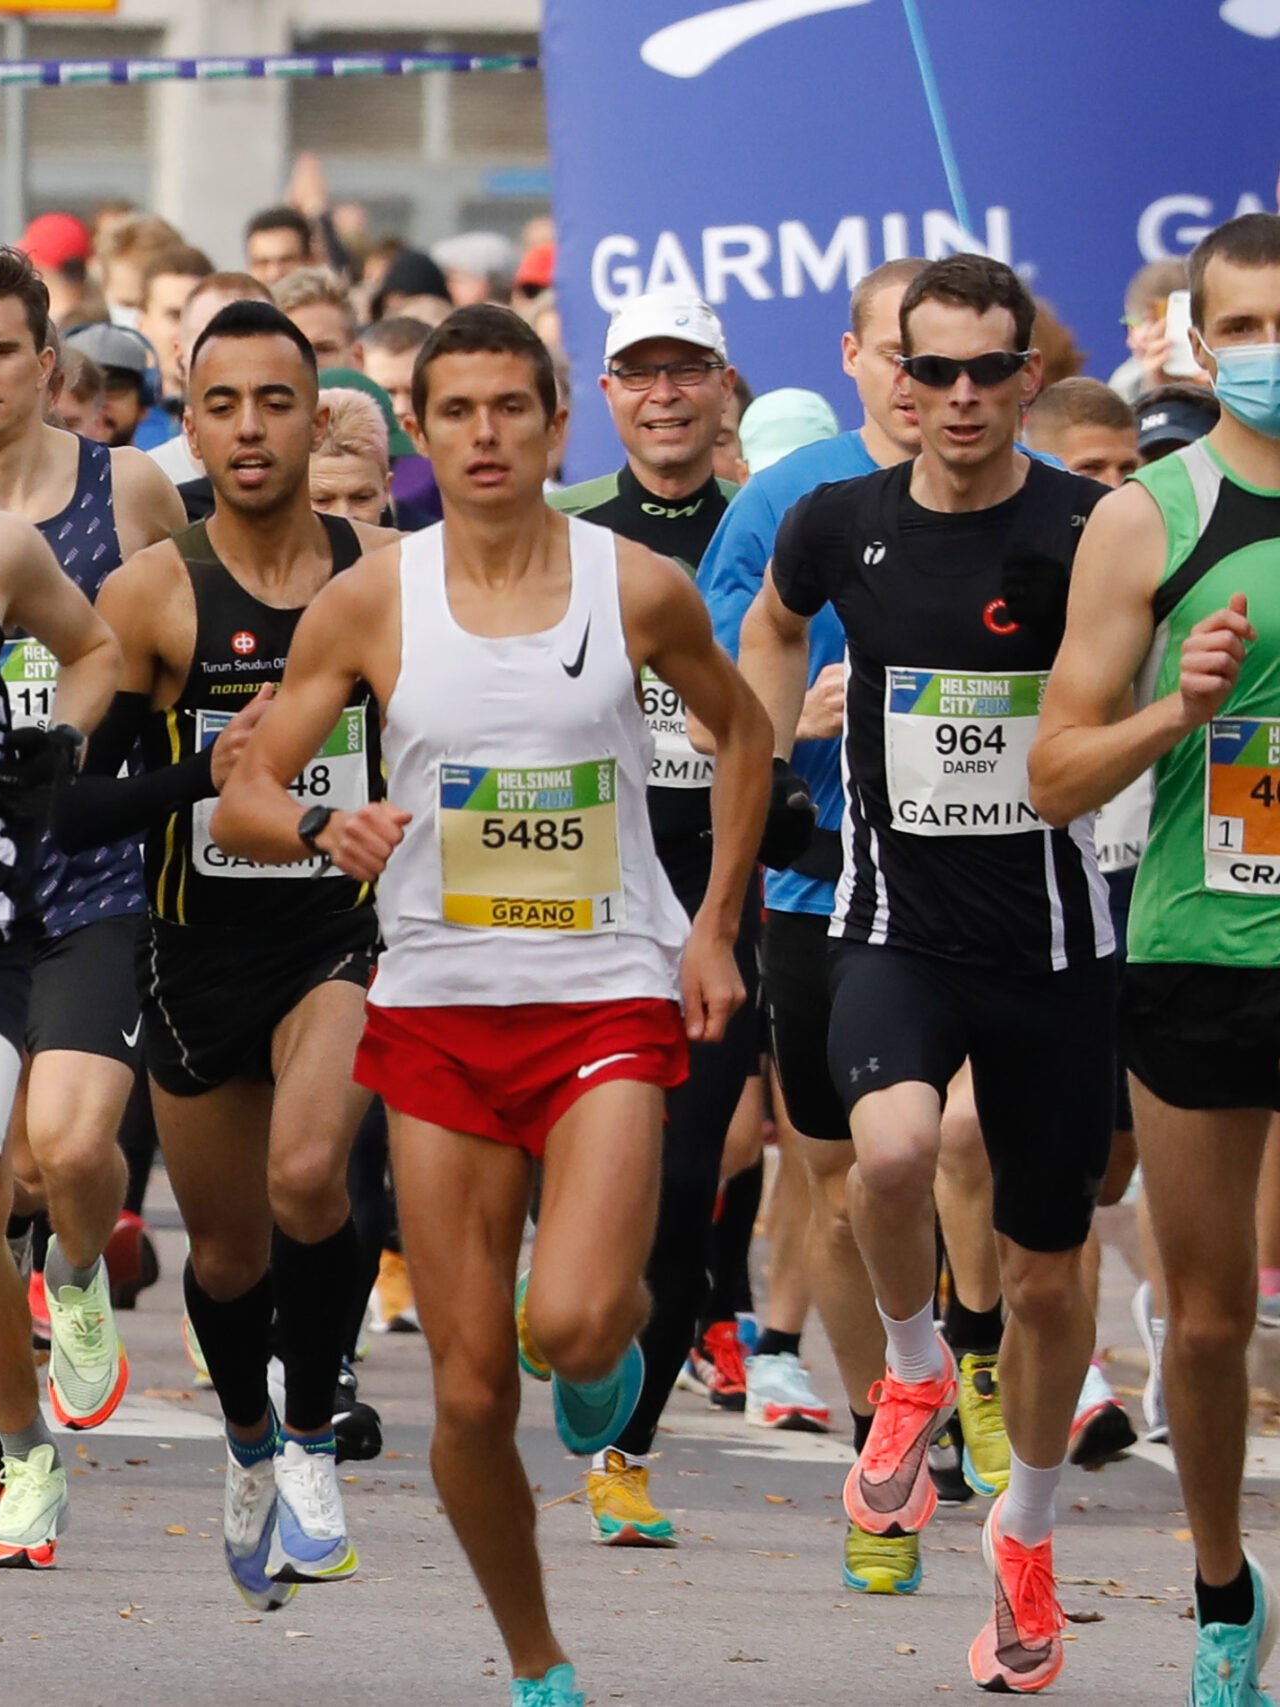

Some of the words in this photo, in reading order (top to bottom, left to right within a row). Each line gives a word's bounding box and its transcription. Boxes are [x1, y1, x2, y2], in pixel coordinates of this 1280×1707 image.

[591, 206, 1012, 312] GARMIN
[201, 661, 232, 673] Turun
[234, 659, 272, 672] Seudun
[939, 678, 1011, 696] HELSINKI
[346, 715, 361, 751] 2021
[935, 723, 1006, 756] 964
[496, 769, 573, 789] HELSINKI
[943, 760, 999, 774] DARBY
[597, 763, 612, 802] 2021
[898, 800, 1040, 827] GARMIN
[481, 817, 584, 851] 5485
[1218, 819, 1234, 848] 1
[491, 902, 575, 924] GRANO
[600, 896, 616, 925] 1
